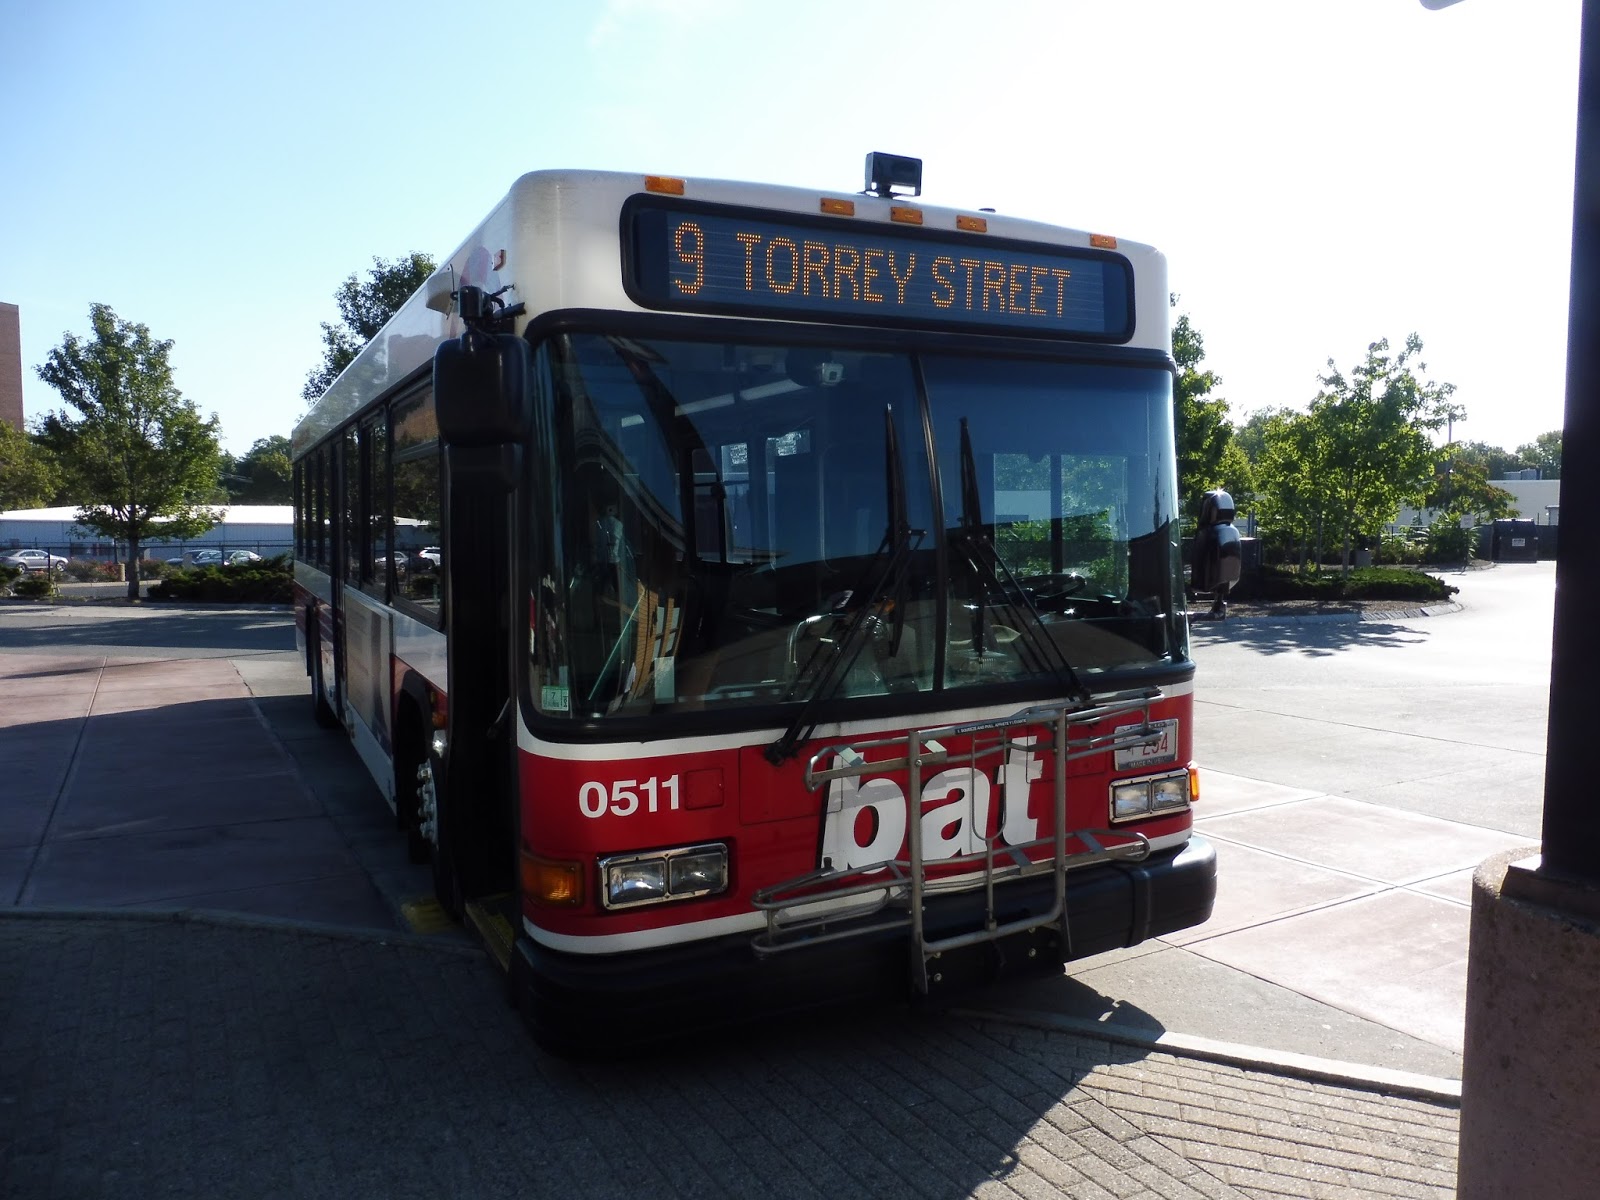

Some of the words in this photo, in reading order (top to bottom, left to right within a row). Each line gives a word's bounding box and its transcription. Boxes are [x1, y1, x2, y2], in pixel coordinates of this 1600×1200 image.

[674, 221, 704, 296] 9
[736, 232, 916, 304] TORREY
[931, 255, 1072, 318] STREET
[578, 774, 679, 818] 0511
[817, 735, 1043, 875] bat
